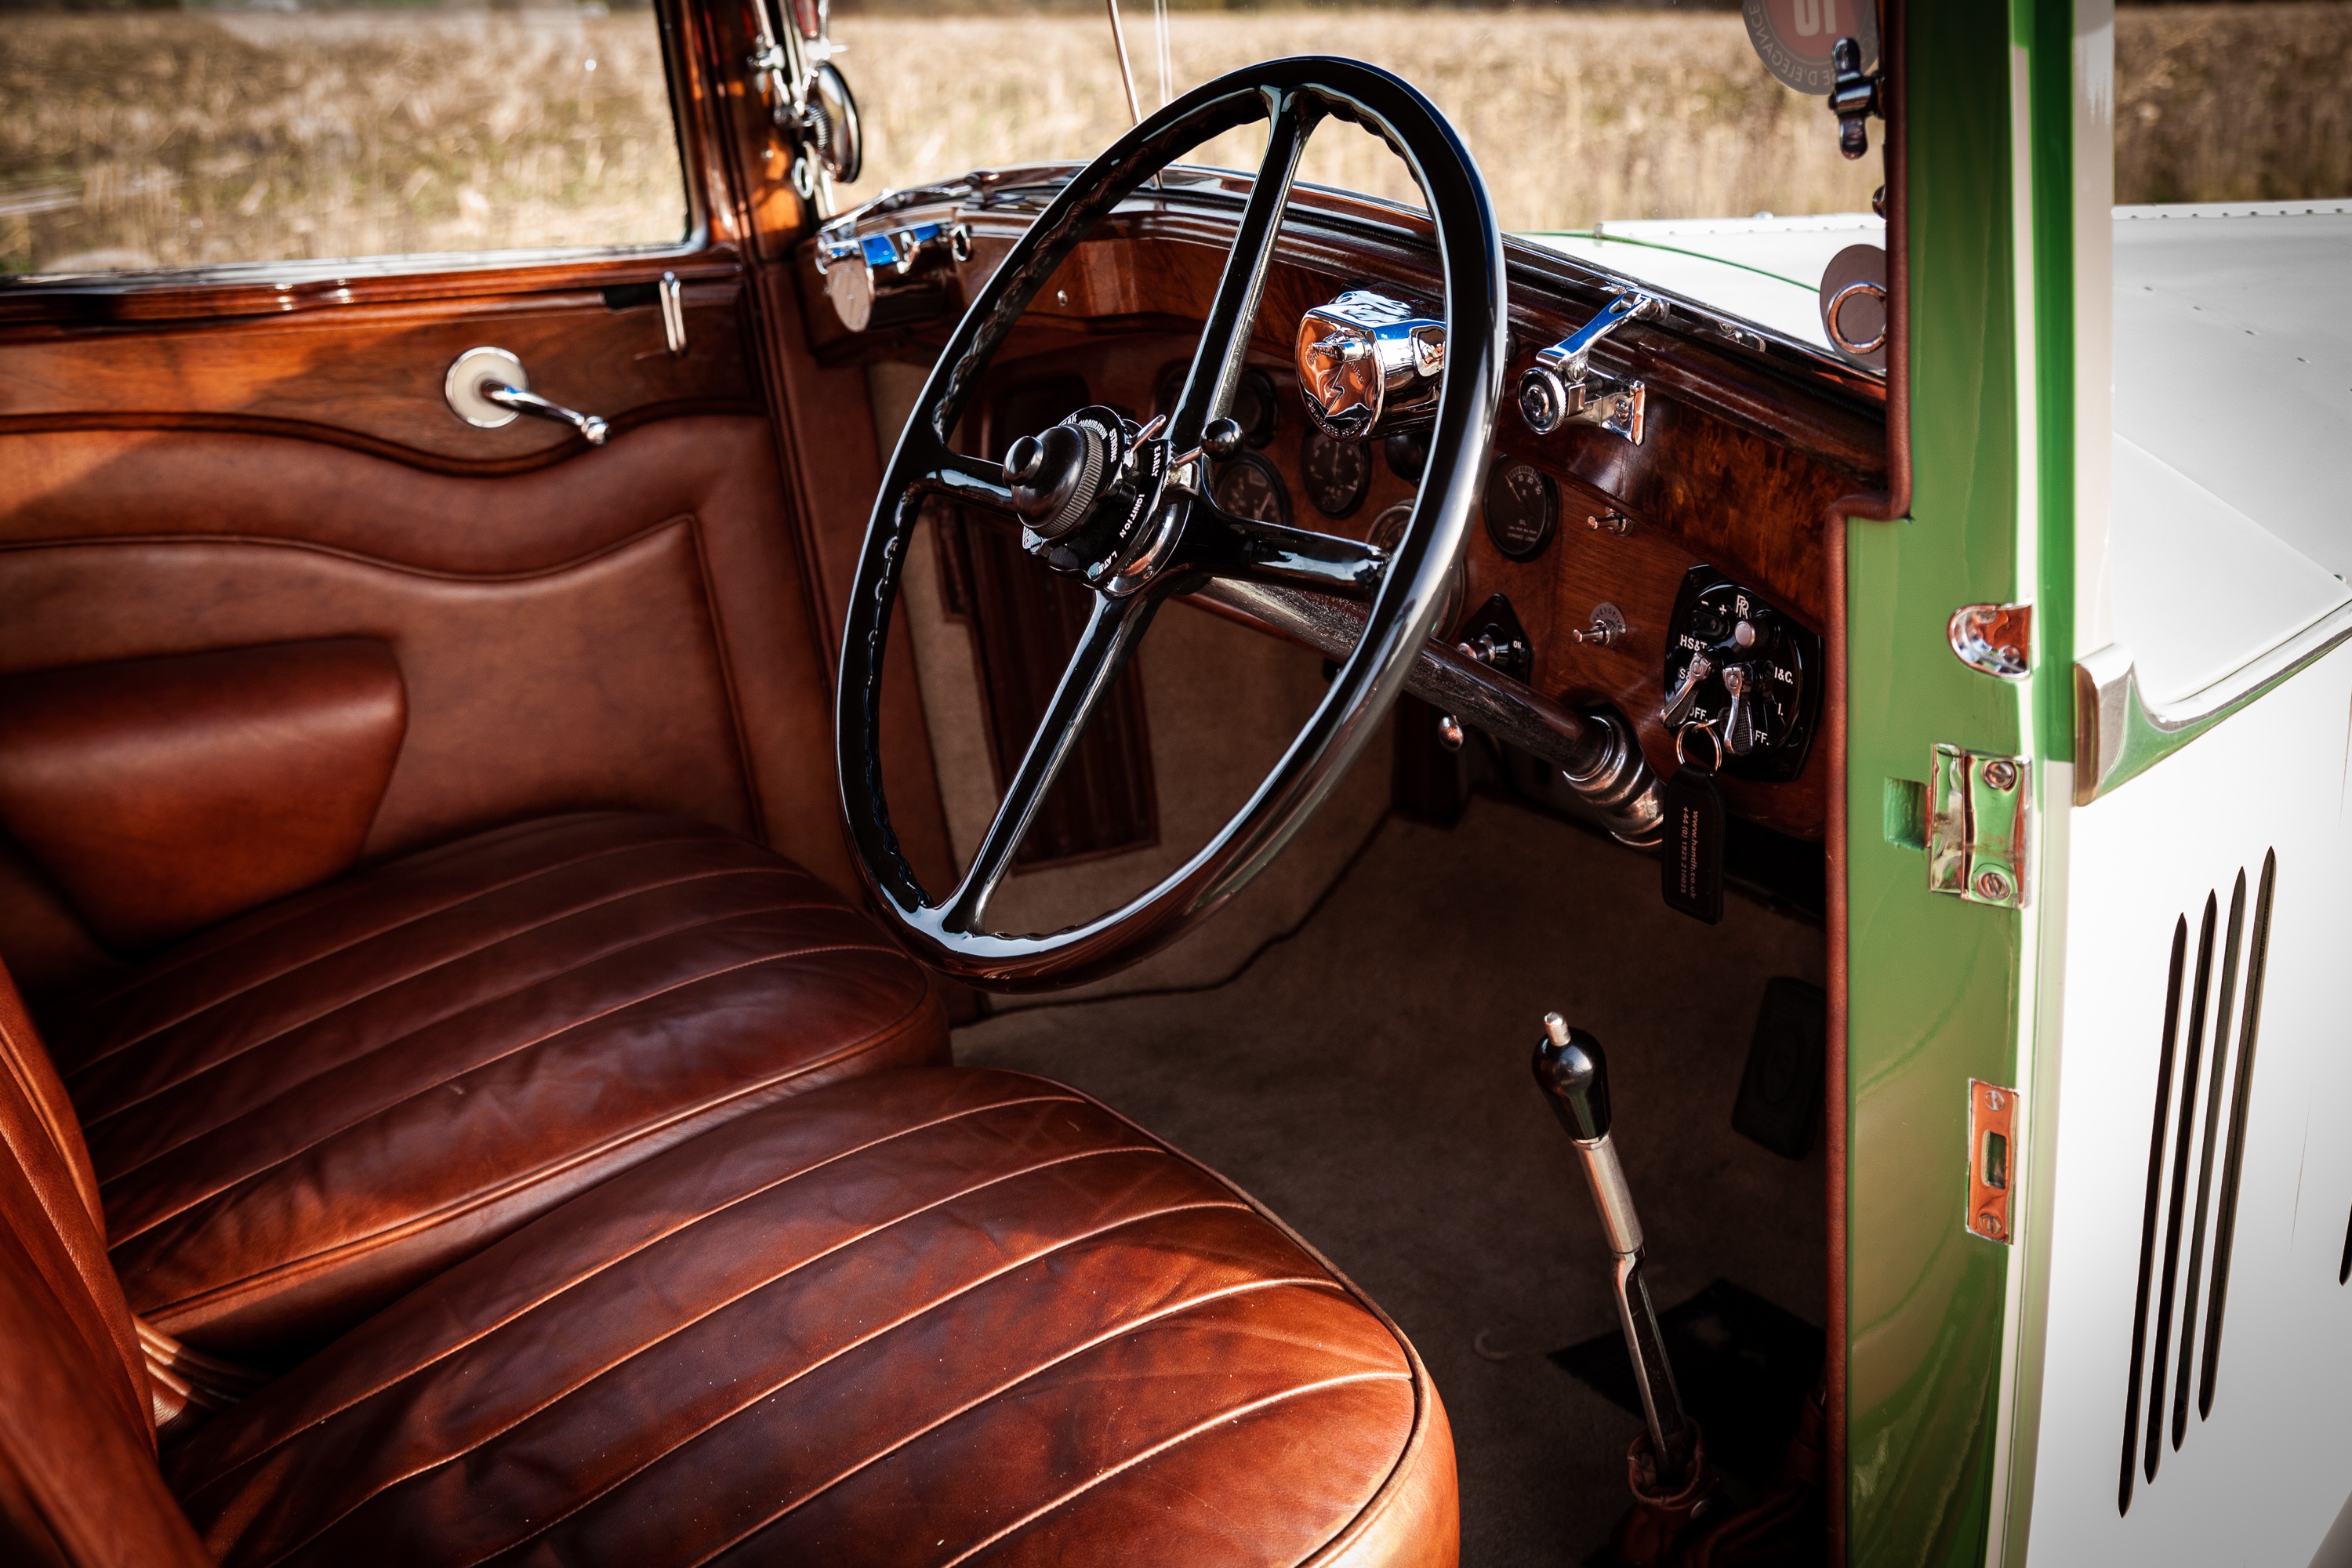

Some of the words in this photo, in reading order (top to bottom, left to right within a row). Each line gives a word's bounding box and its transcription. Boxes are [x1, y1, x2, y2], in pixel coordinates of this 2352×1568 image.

[1109, 427, 1118, 463] STRONG
[1151, 445, 1161, 477] EARLY
[1119, 493, 1145, 539] IGNITION
[1097, 550, 1118, 574] LATE
[1513, 641, 1522, 649] ON
[1690, 811, 1699, 899] www.handh.co.uk
